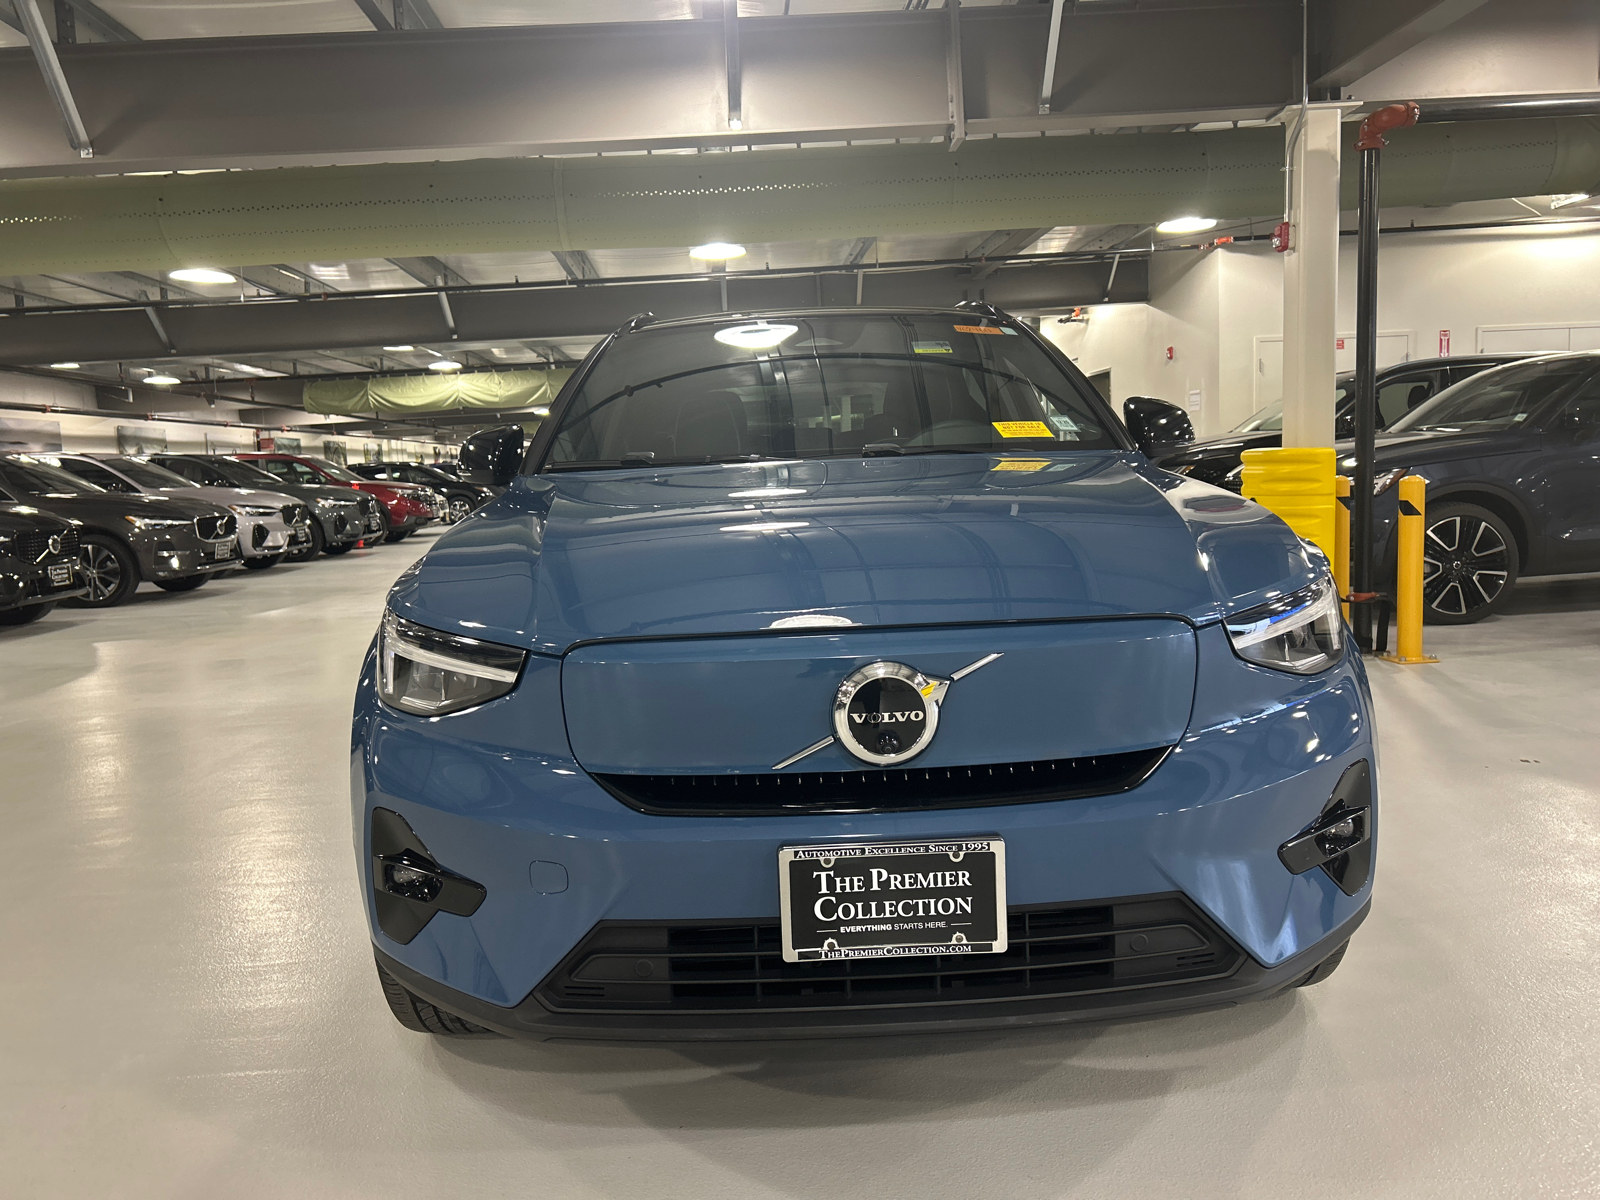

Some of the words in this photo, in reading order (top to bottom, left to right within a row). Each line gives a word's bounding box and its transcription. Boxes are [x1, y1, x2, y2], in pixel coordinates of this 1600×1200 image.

[850, 710, 924, 724] VOLVO
[796, 849, 862, 859] AUTOMOTIVE
[864, 846, 926, 856] EXCELLENCE
[928, 844, 958, 853] SINCE
[962, 842, 989, 851] 1995
[812, 870, 865, 894] THE
[869, 868, 973, 892] PREMIER
[813, 896, 973, 922] COLLECTION
[840, 924, 892, 933] EVERYTHING
[894, 922, 924, 931] STARTS
[925, 921, 949, 929] HERE.
